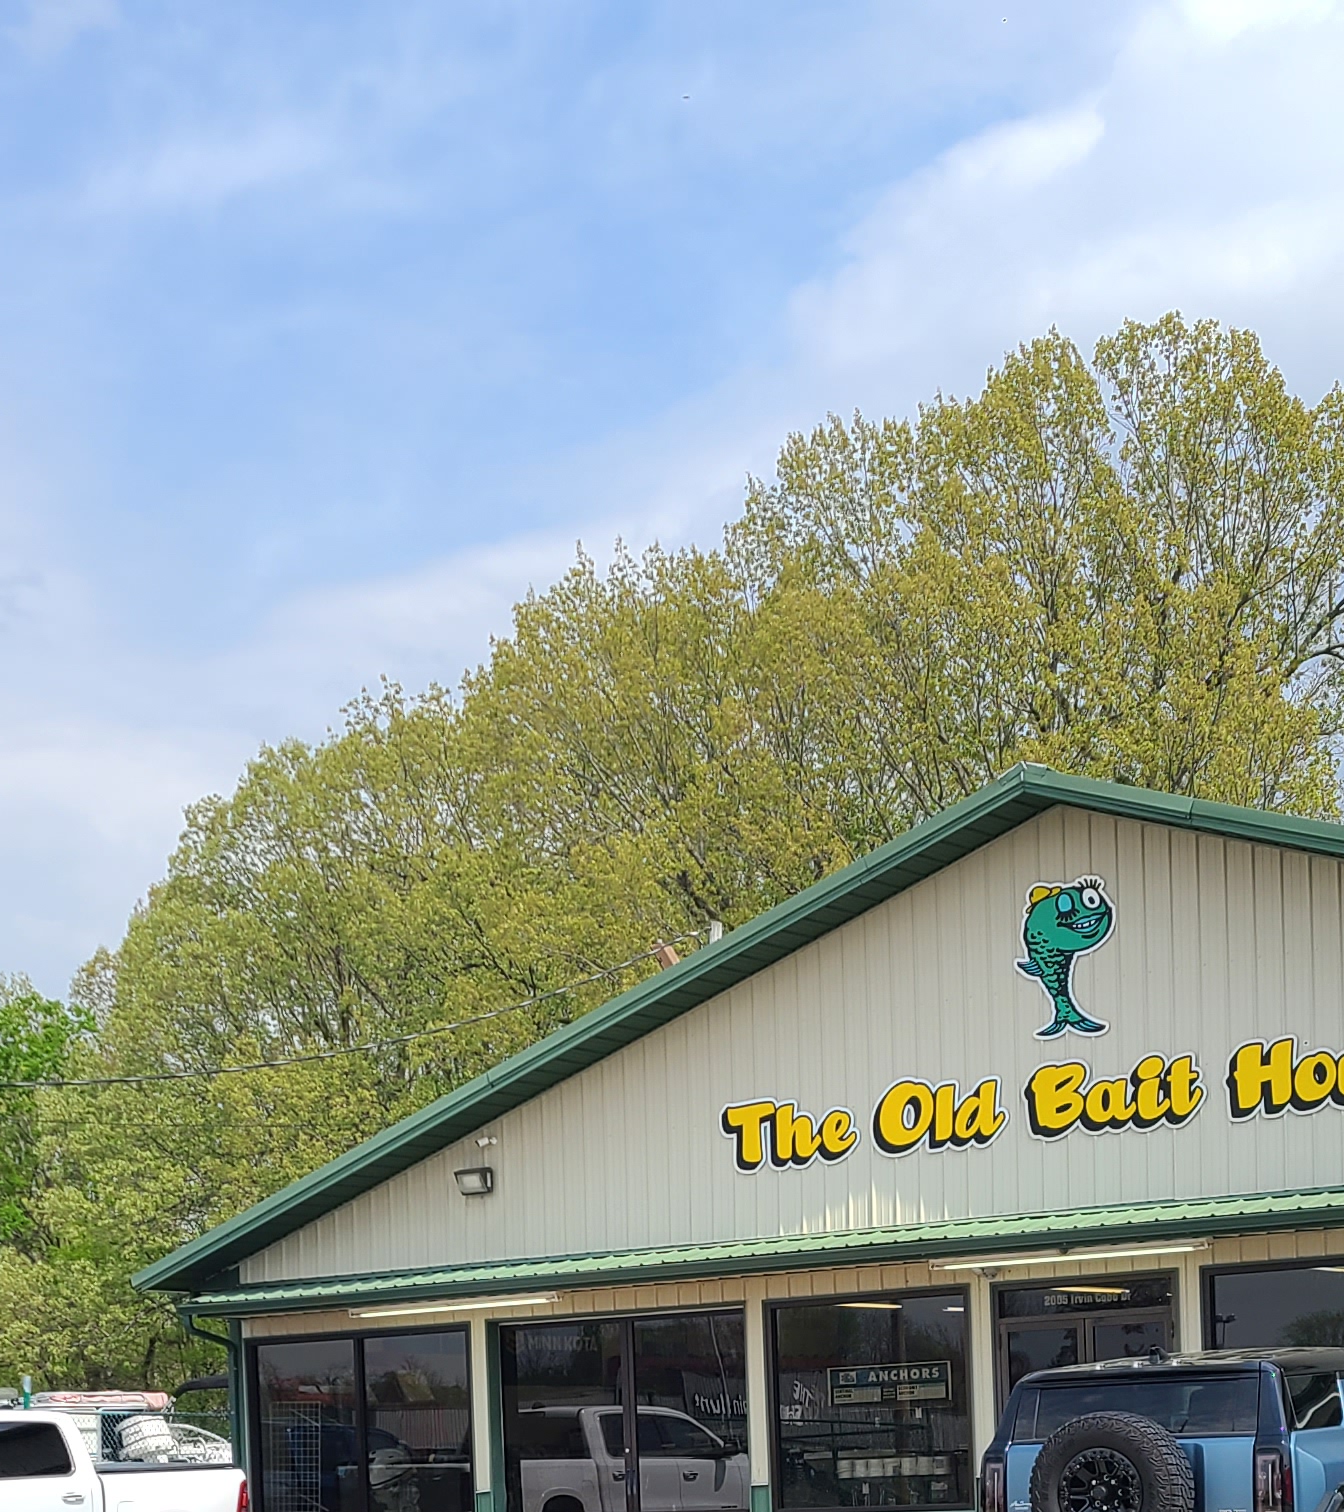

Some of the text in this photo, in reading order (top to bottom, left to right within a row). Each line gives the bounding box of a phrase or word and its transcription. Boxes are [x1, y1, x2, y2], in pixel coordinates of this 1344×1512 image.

[724, 1101, 856, 1170] The
[873, 1079, 1005, 1155] Old
[1027, 1056, 1204, 1139] Bait
[564, 1334, 598, 1351] KOTA
[867, 1367, 940, 1382] ANCHORS
